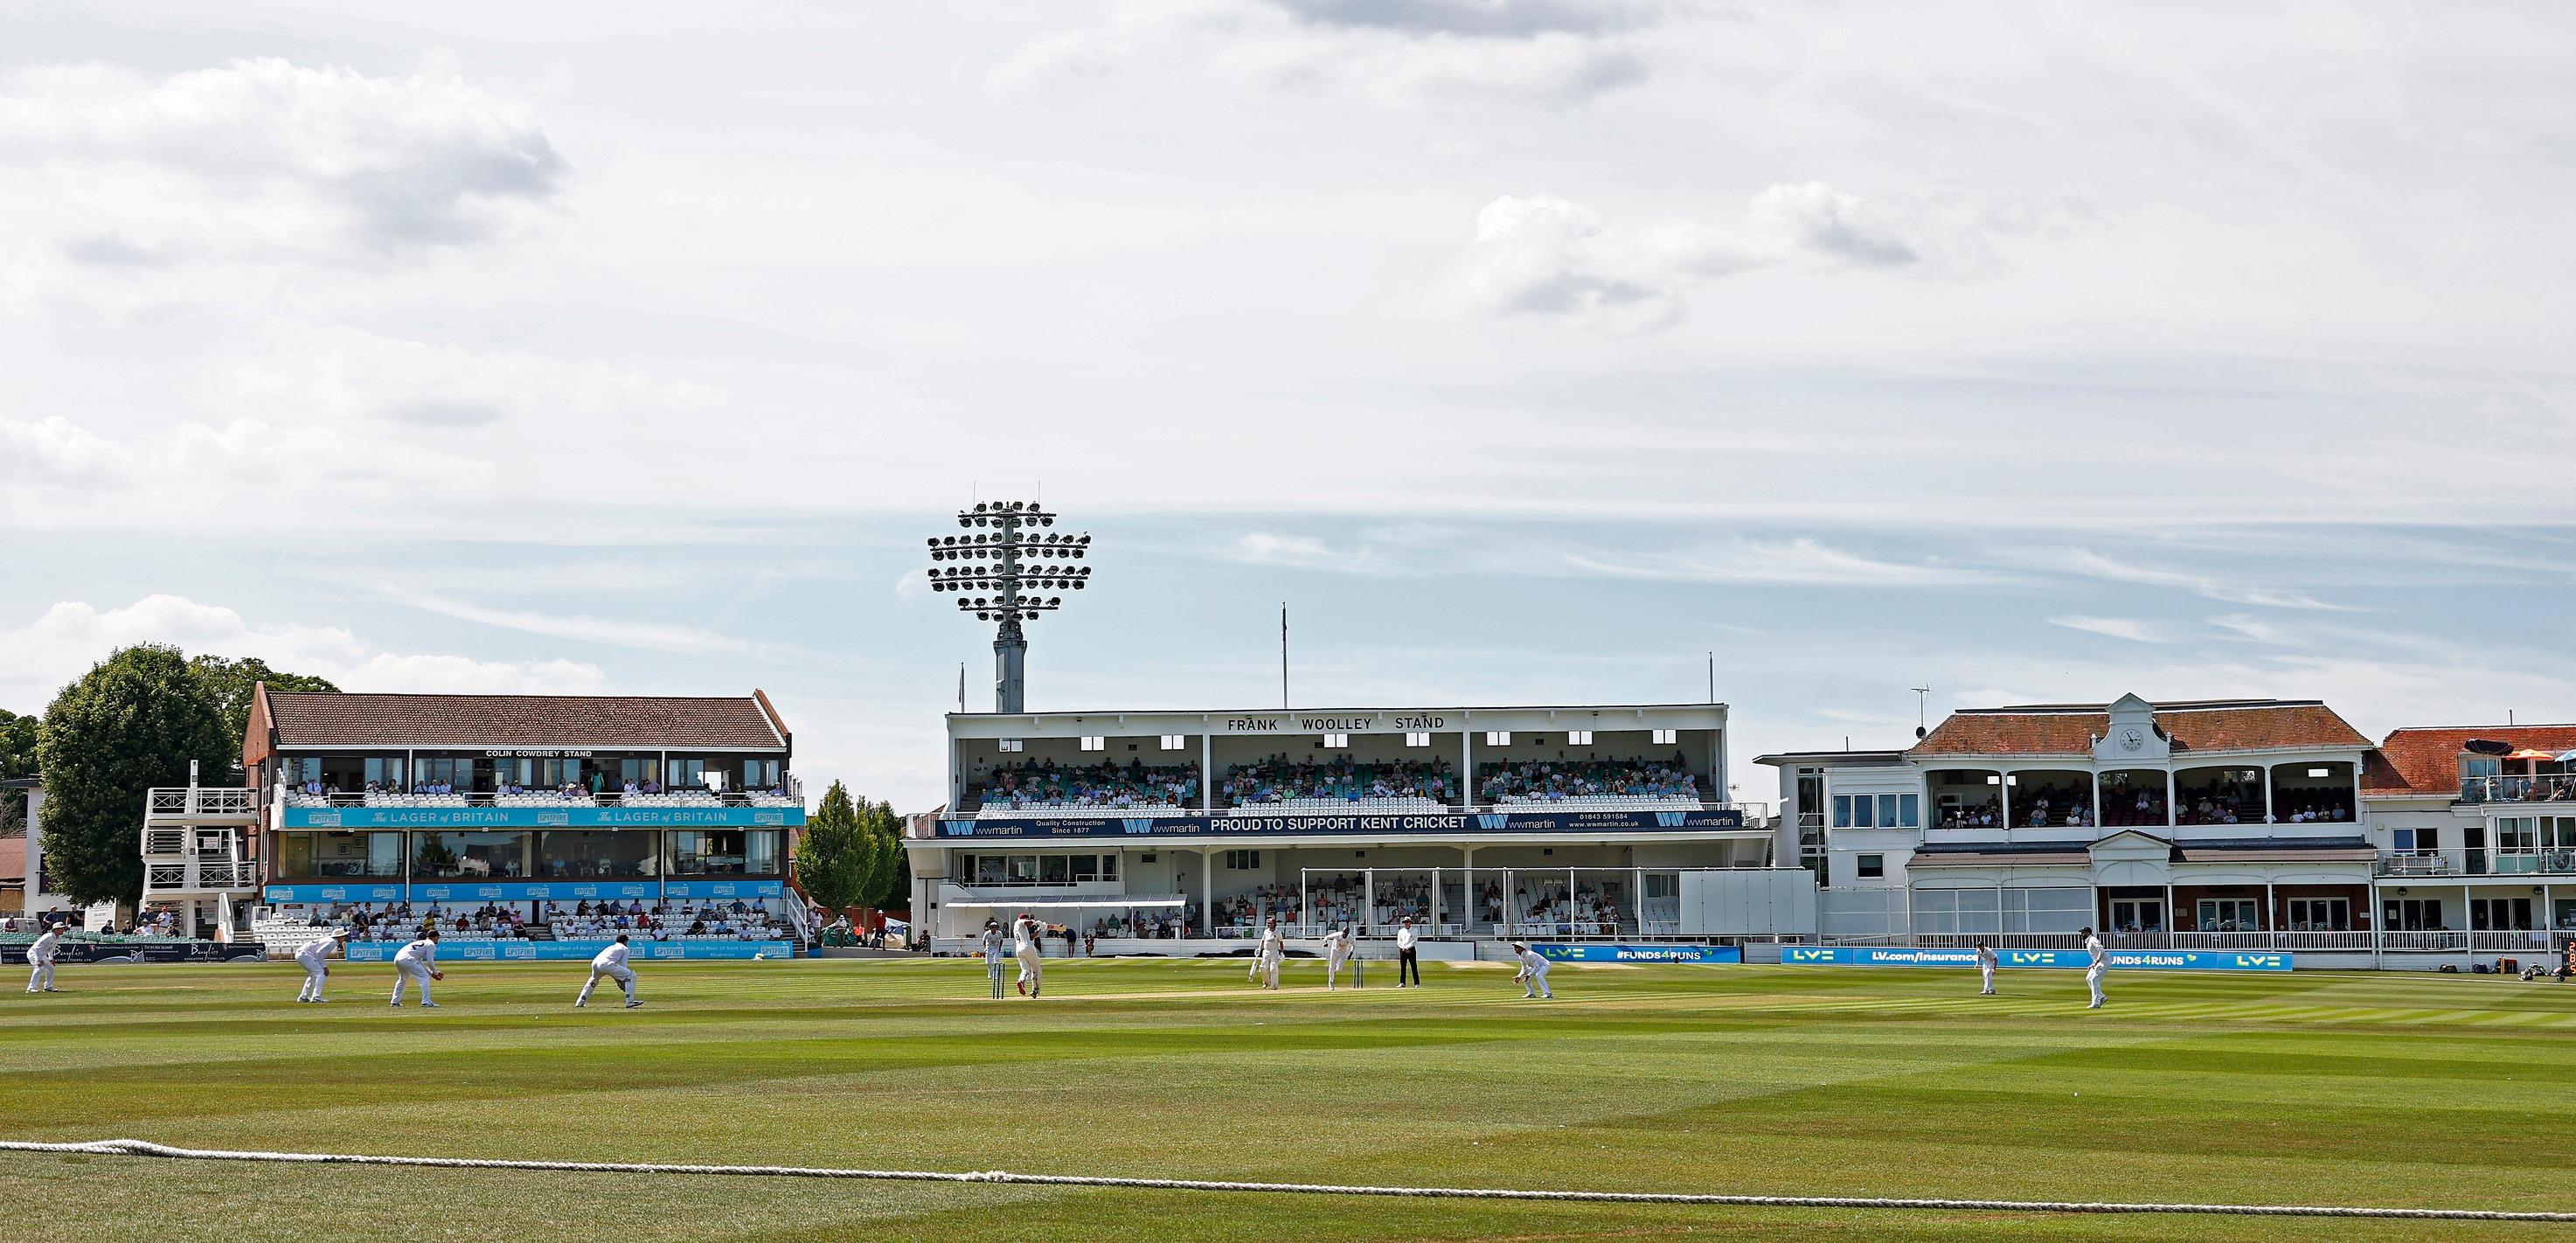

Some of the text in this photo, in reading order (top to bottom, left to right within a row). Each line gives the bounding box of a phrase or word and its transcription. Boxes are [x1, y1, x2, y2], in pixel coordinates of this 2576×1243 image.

[1228, 717, 1444, 731] FRANK WOOLLEY STAND
[309, 814, 341, 823] SPITFIRE
[372, 811, 509, 823] The LAGER of BRITAIN
[538, 813, 567, 823] SPITFIRE
[597, 811, 727, 823] The LAGER of BRITAIN
[755, 813, 783, 823] SPITFIRE
[1686, 816, 1734, 827] wwmartin
[1153, 823, 1200, 833] wwmartin
[1211, 816, 1468, 831] PROUD TO SUPPORT KENT CRICKET
[1508, 819, 1556, 829] wwmartin
[976, 825, 1023, 835] wwmartin
[412, 941, 425, 950] 2
[507, 948, 535, 956] SPITFIRE
[656, 947, 684, 955] SPITFIRE
[1616, 949, 1700, 960] #FUNDS4RUNS
[1871, 951, 1978, 963] LV.com/insurance
[2112, 955, 2184, 966] UNDS4RUNS
